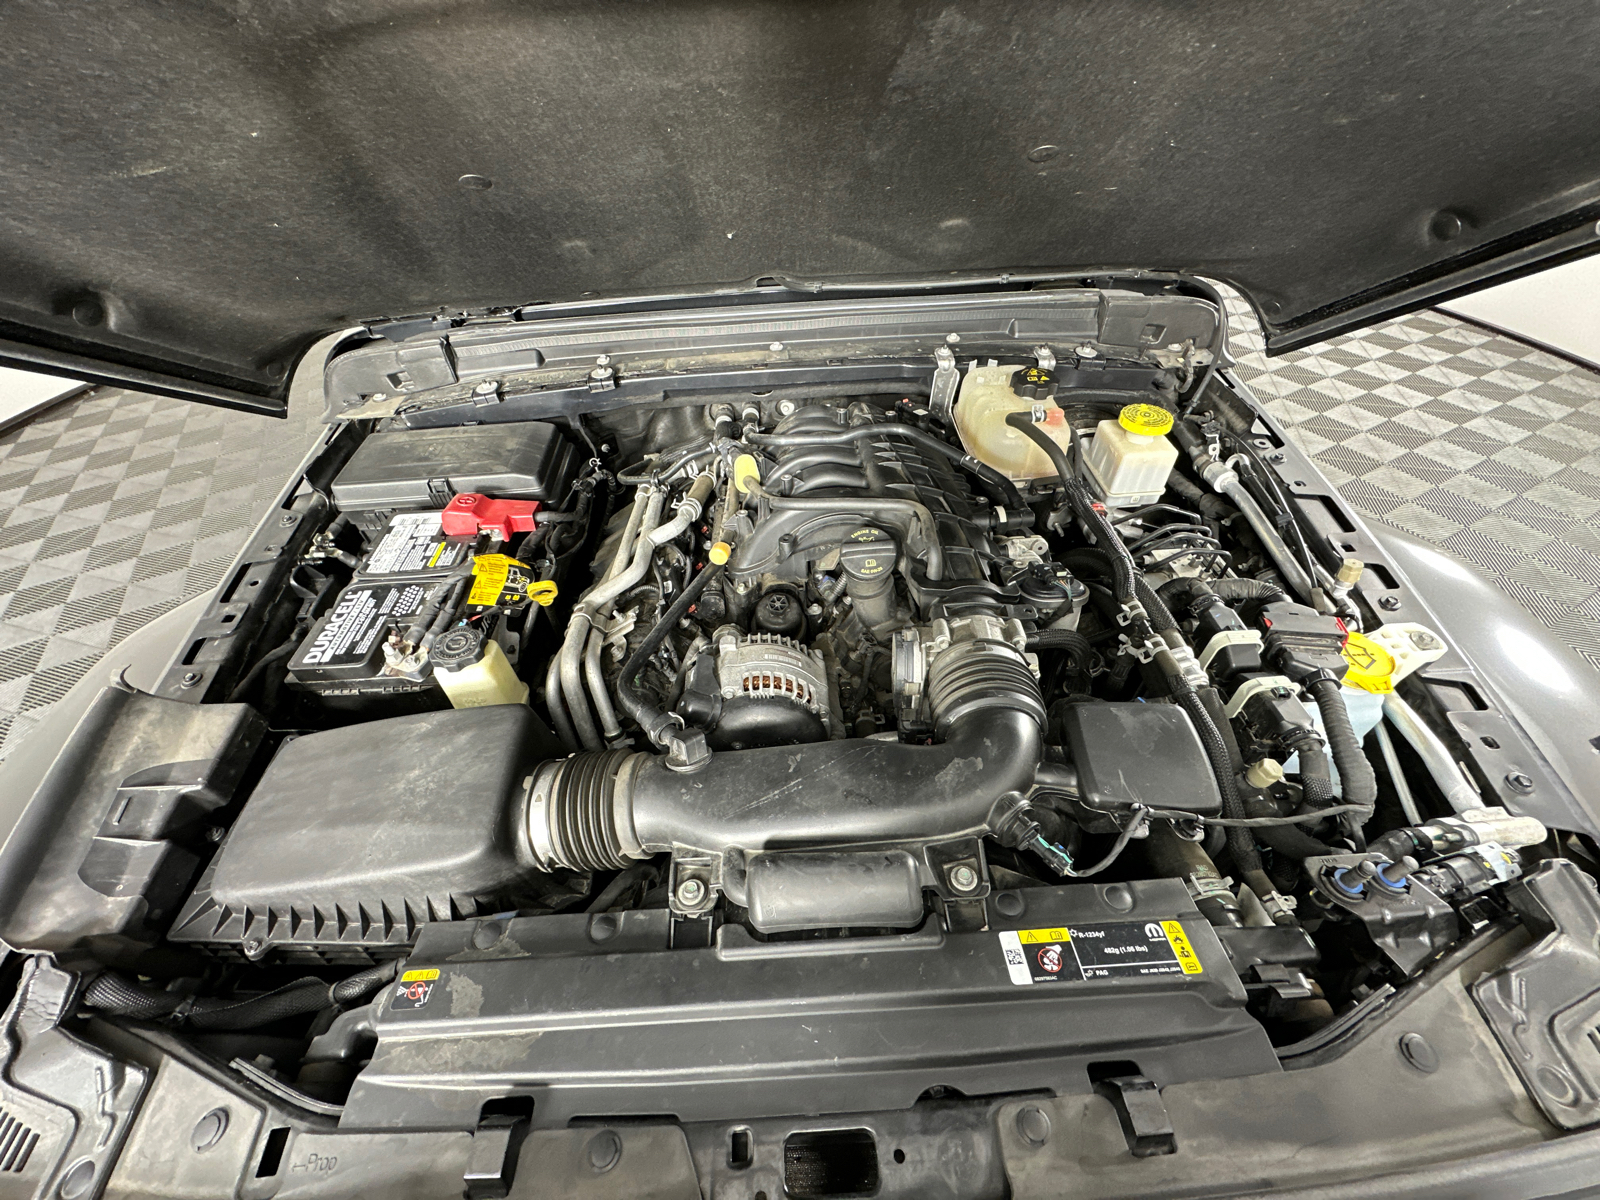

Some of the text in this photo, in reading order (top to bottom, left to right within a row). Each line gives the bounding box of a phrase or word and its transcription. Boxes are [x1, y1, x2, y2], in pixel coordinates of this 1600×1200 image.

[851, 529, 869, 538] ENGINE
[302, 590, 363, 664] DURACELL
[330, 614, 354, 650] AUTOMOTIVE
[1078, 931, 1105, 939] R-1234yf
[1104, 947, 1120, 955] 482g
[1135, 944, 1148, 953] lbs)
[305, 1153, 338, 1175] Prop
